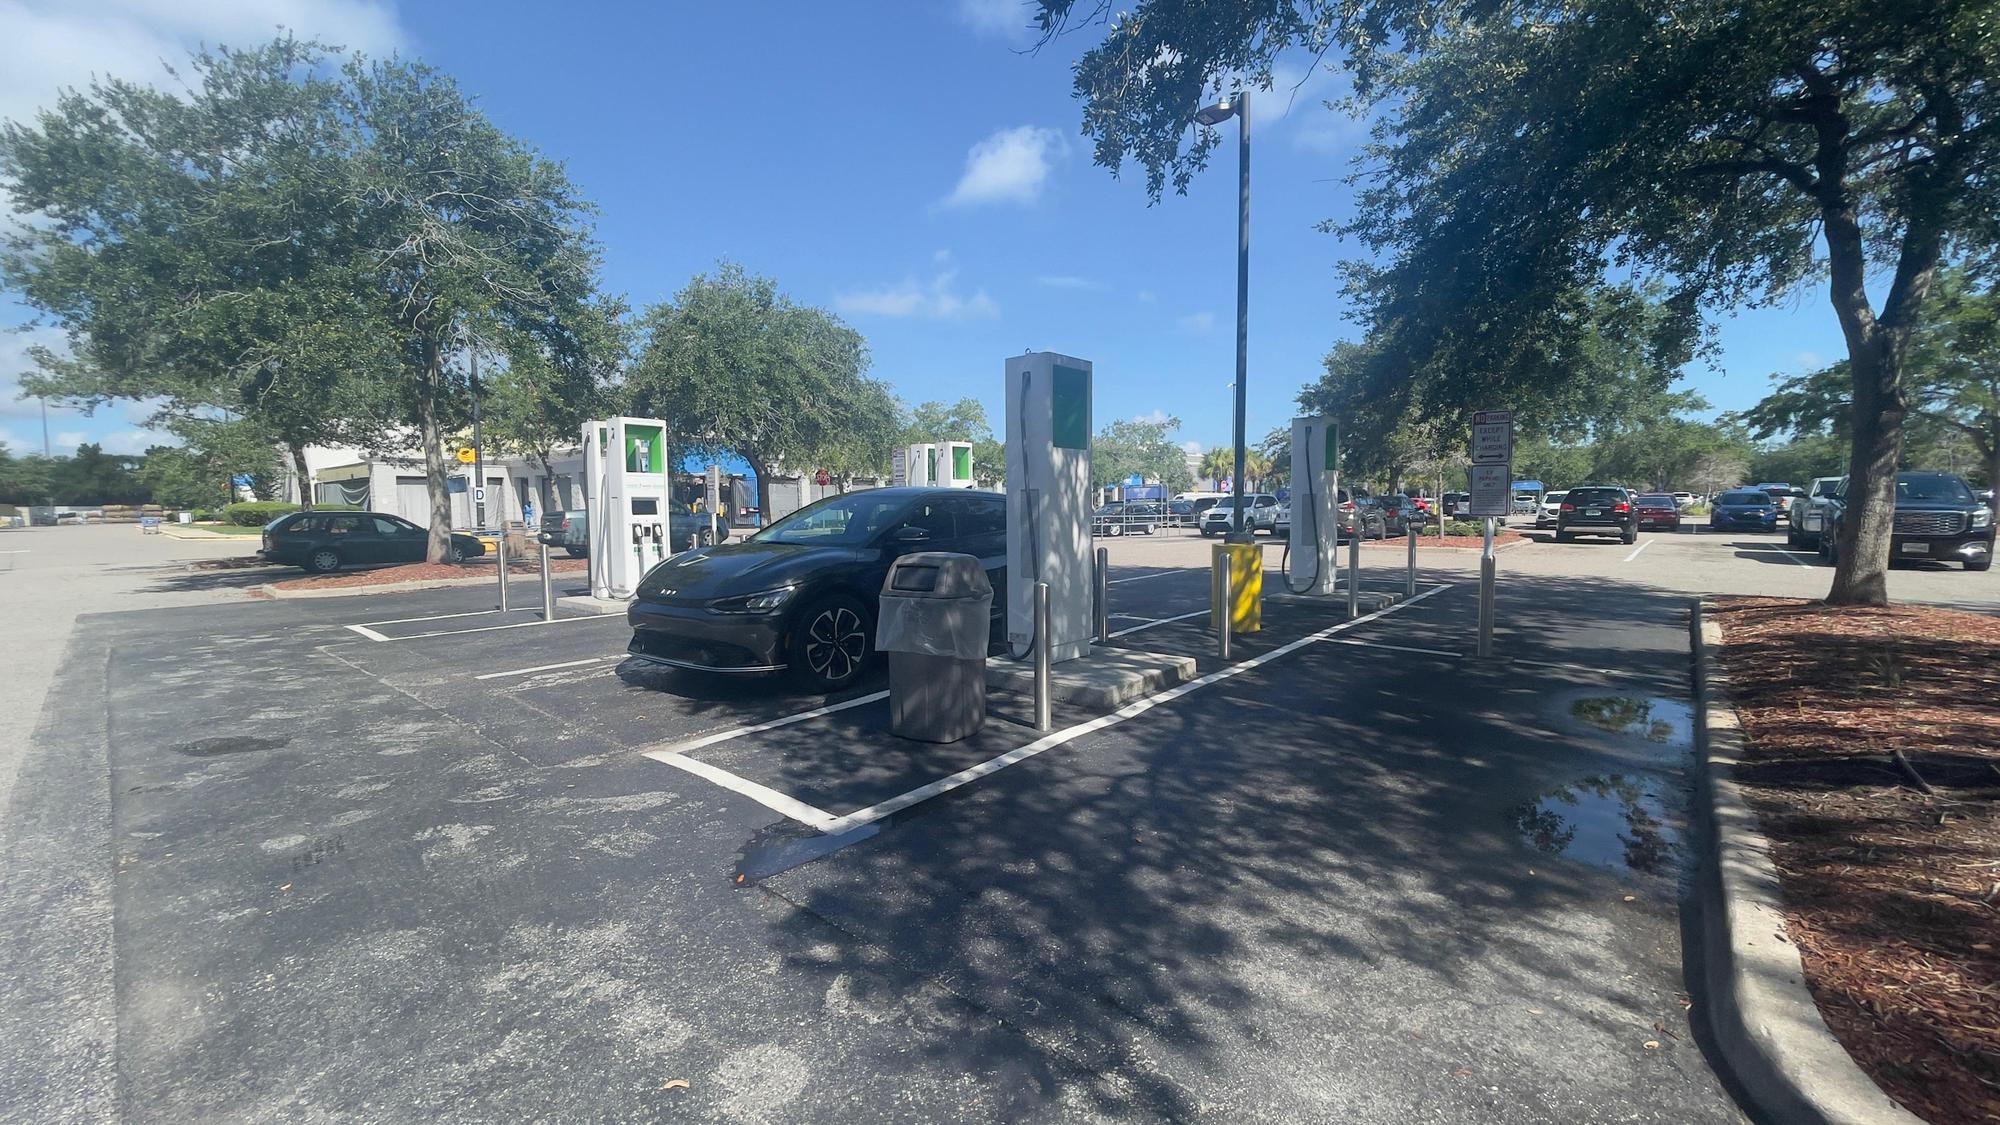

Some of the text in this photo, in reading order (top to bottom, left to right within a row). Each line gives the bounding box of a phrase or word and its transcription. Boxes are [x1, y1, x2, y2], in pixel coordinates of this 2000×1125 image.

[1475, 414, 1486, 423] NO
[1475, 443, 1507, 451] CHARGING
[476, 489, 485, 500] D
